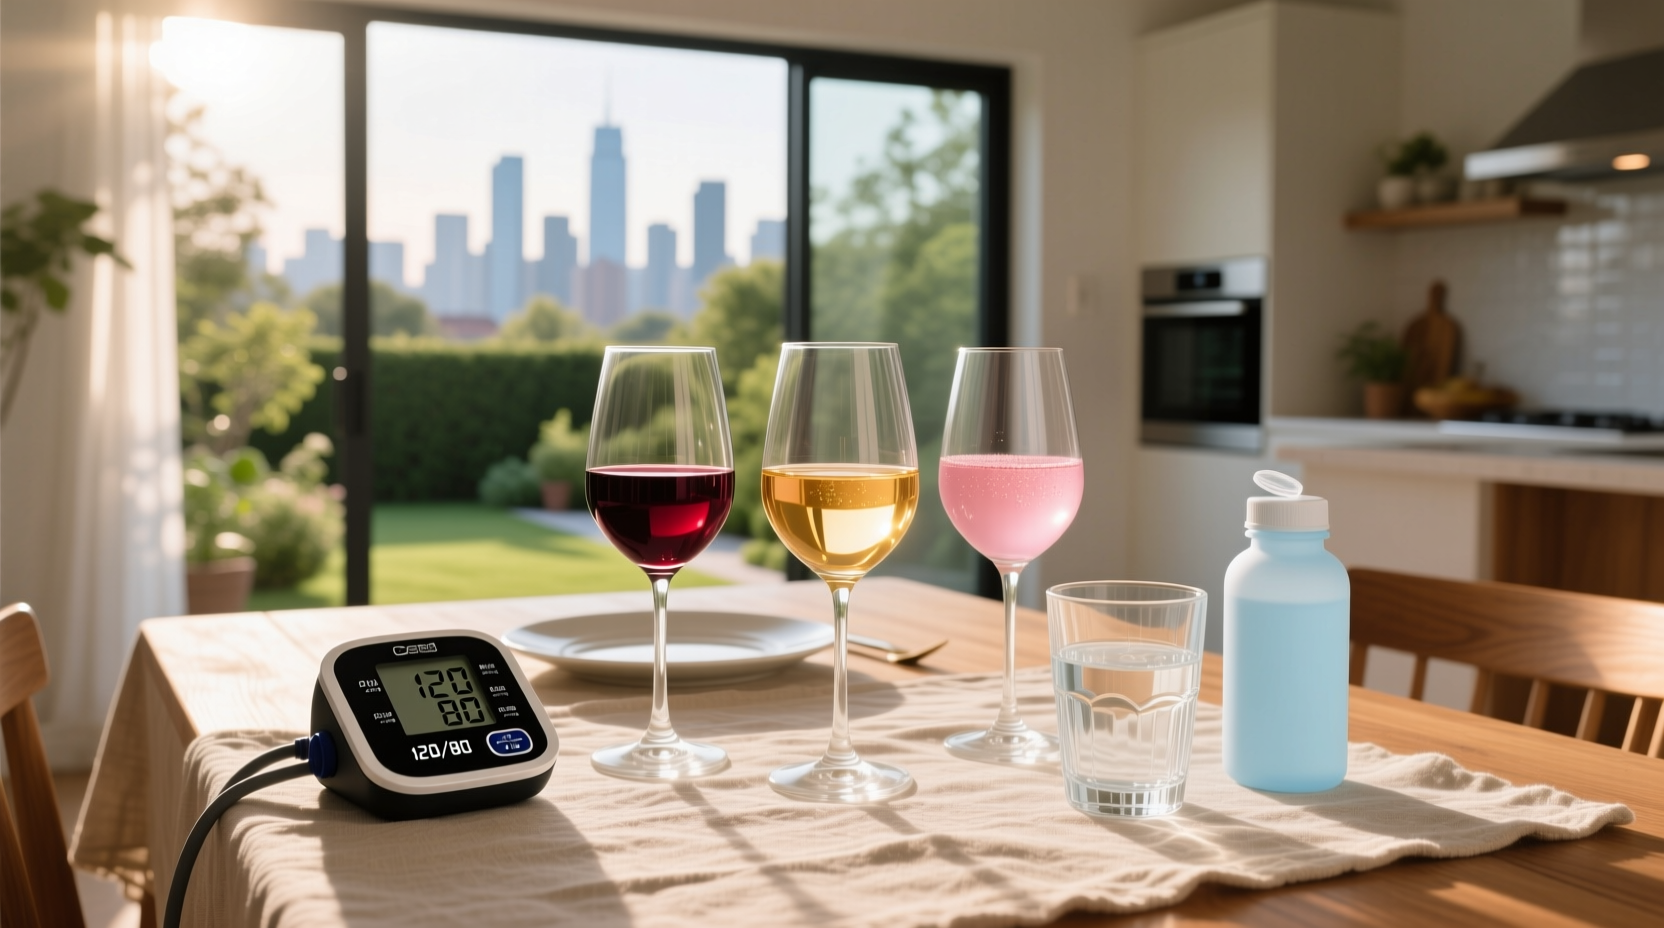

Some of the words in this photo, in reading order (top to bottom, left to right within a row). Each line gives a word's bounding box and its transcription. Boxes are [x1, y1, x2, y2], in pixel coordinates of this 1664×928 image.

[414, 667, 473, 698] 120
[437, 697, 485, 726] 80
[411, 739, 473, 761] 120/80
